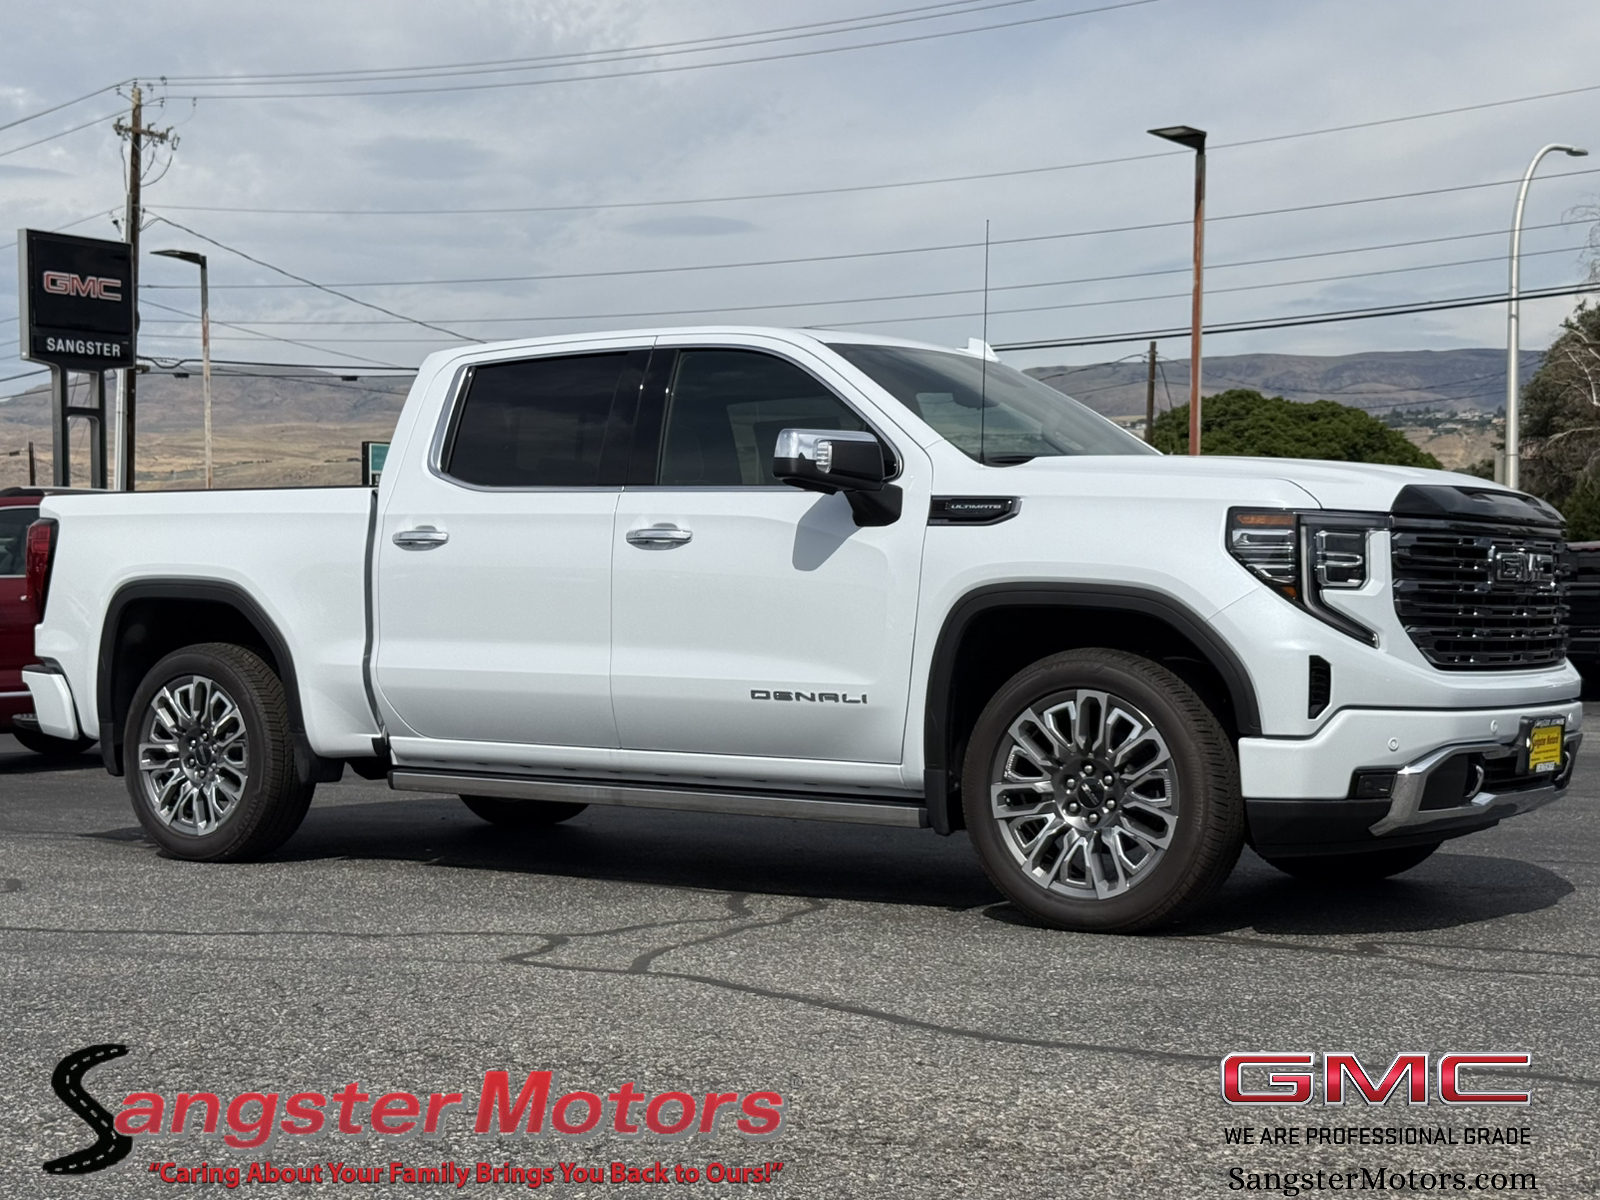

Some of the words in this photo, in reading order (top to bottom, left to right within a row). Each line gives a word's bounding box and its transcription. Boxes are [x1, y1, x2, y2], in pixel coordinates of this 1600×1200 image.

[43, 270, 122, 302] GMC
[46, 337, 121, 357] SANGSTER
[1496, 552, 1554, 583] GMC
[750, 689, 868, 704] DENALI
